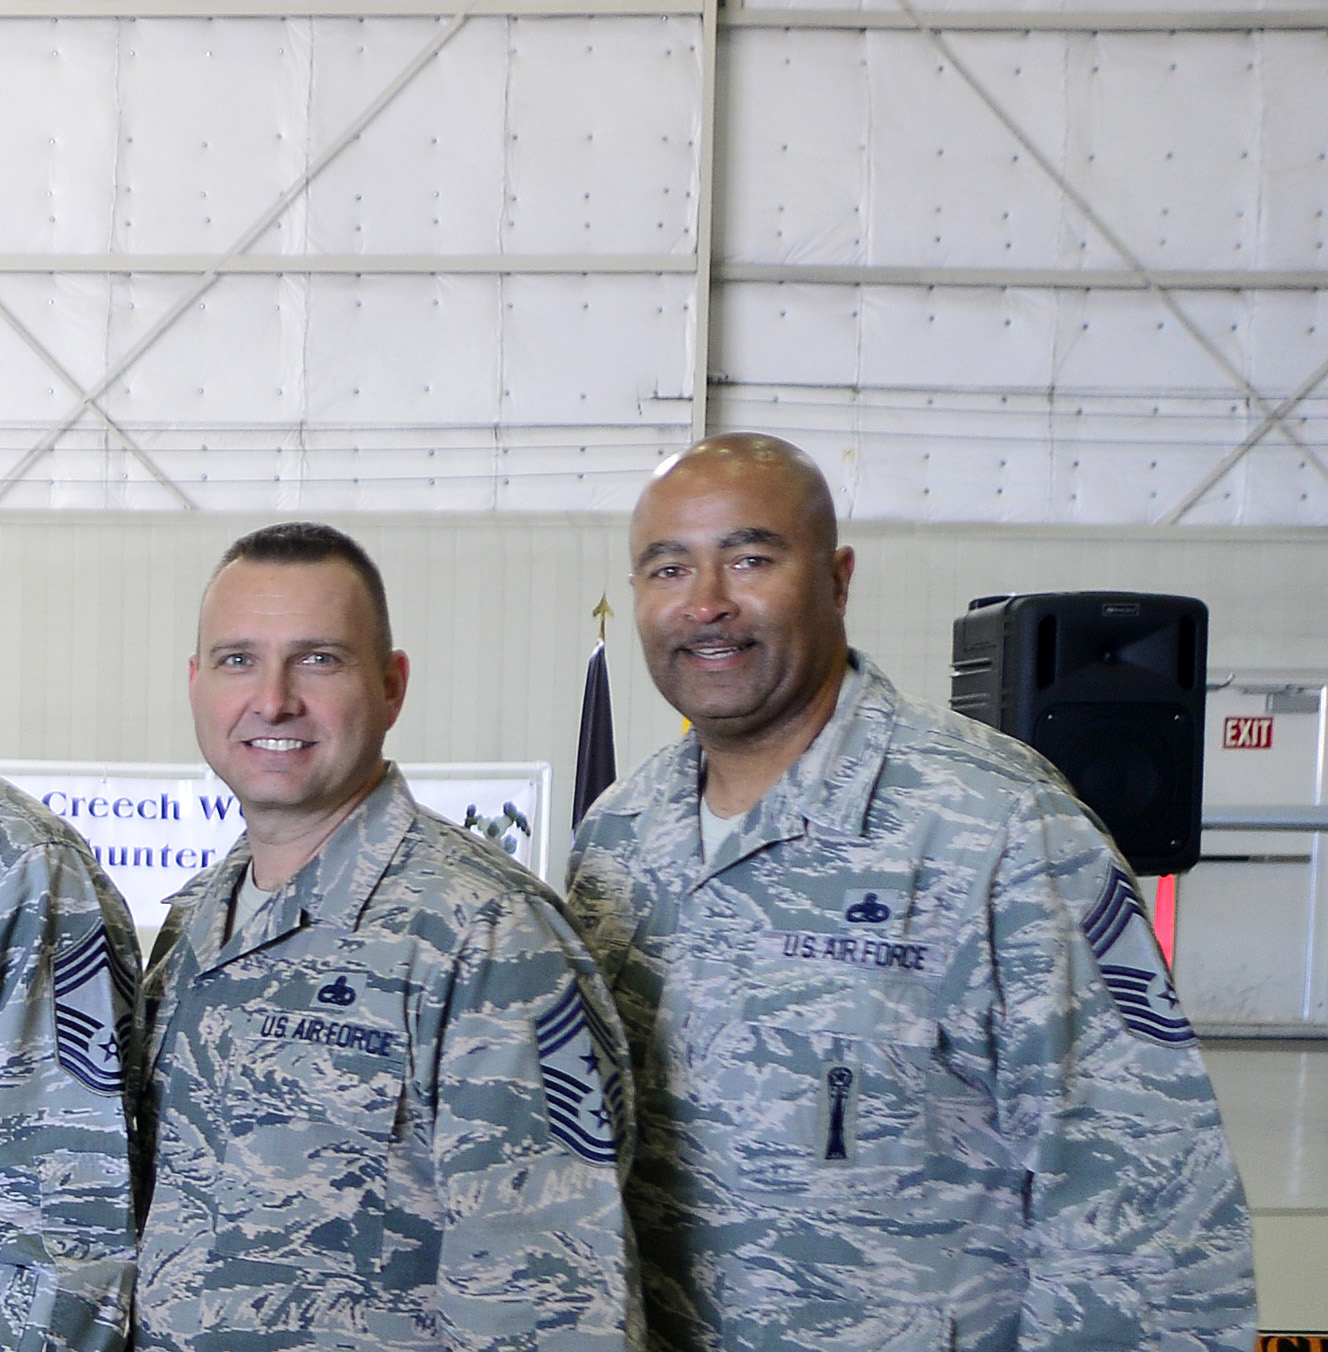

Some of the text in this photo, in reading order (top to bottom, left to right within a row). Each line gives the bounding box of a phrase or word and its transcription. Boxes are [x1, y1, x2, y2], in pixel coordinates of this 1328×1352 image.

[1226, 719, 1271, 747] EXIT
[41, 791, 245, 820] Creech W
[824, 938, 857, 962] AIR
[861, 940, 928, 970] FORCE
[292, 1018, 324, 1042] AIR
[325, 1022, 393, 1056] FORCE
